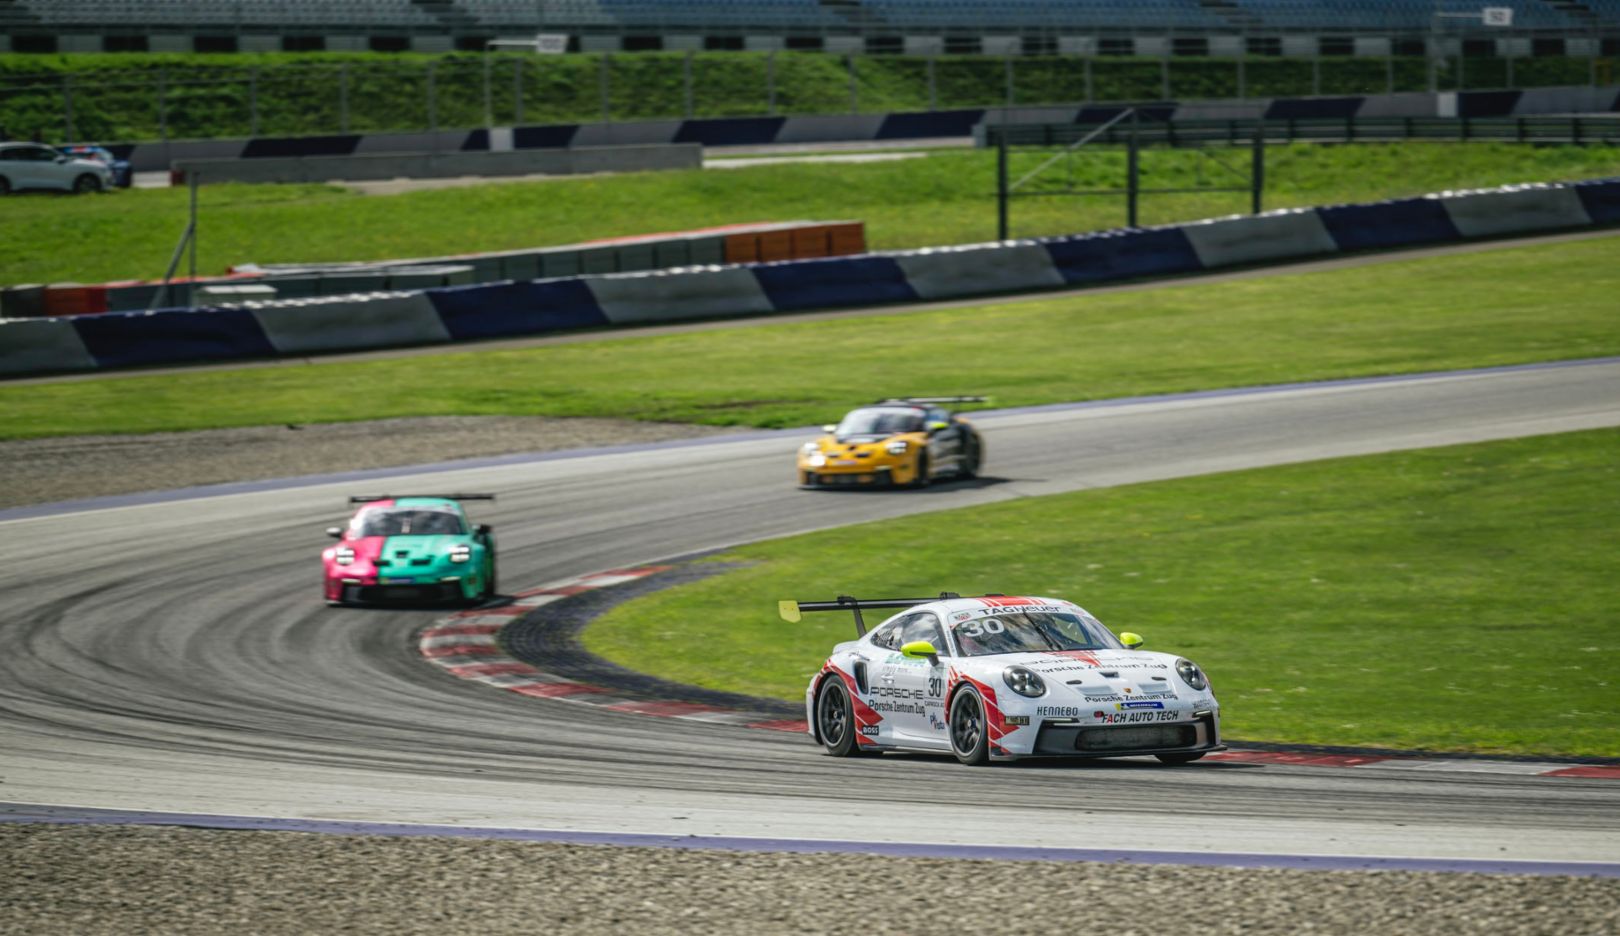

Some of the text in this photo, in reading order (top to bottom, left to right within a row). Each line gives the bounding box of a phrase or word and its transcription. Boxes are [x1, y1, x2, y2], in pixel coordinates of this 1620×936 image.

[961, 618, 1005, 638] 30
[870, 686, 924, 699] PORSCHE
[928, 677, 942, 698] 30
[1084, 693, 1179, 703] Porsche Zentrum Zug
[868, 699, 893, 712] Porsche
[893, 701, 914, 714] Zentrum
[914, 702, 926, 717] Zug
[1037, 706, 1079, 717] HENNEBO
[1102, 710, 1179, 723] FACH AUTO TECH
